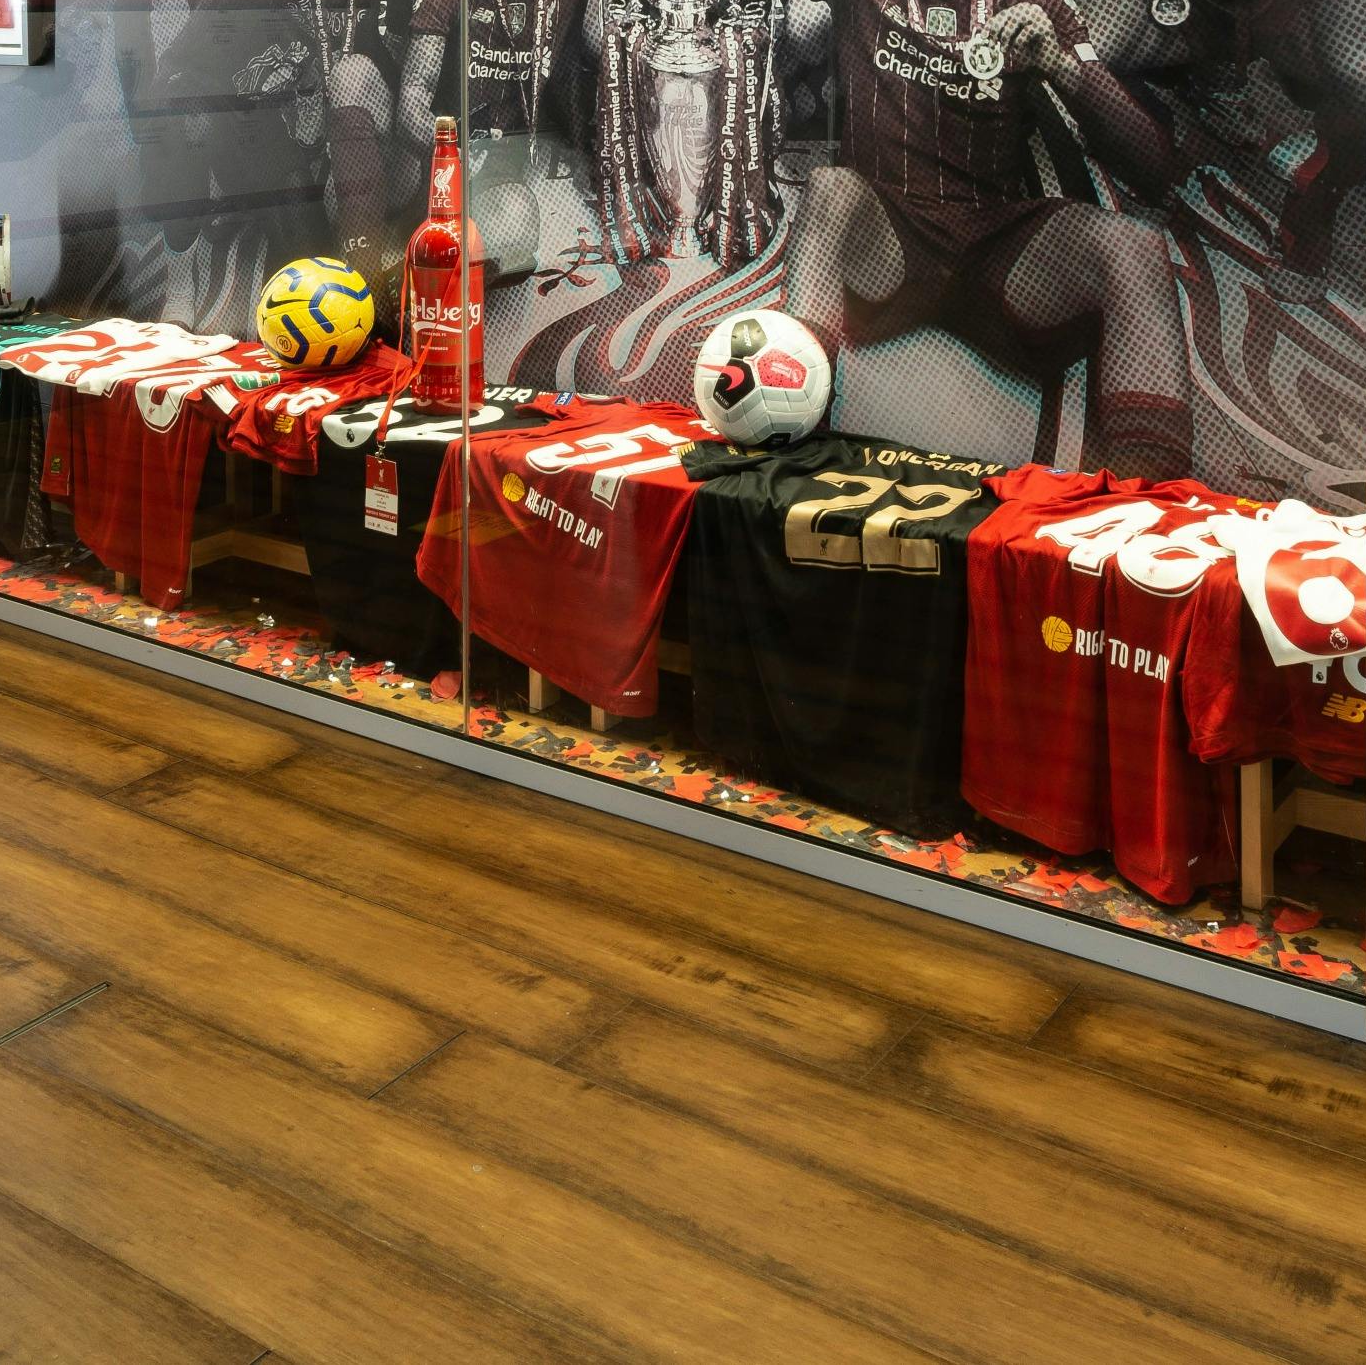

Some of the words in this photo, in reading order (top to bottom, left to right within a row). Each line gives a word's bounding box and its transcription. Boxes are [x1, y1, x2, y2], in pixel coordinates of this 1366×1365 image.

[608, 35, 620, 88] League
[725, 26, 739, 79] League
[876, 49, 972, 100] Chartered
[722, 81, 737, 136] Premier
[744, 59, 757, 114] League
[609, 90, 622, 142] Premier
[747, 116, 759, 171] Premier
[525, 486, 557, 522] RIGHT
[557, 507, 574, 534] TO
[574, 518, 603, 550] PLAY
[1108, 638, 1128, 669] TO
[1133, 648, 1170, 684] PLAY
